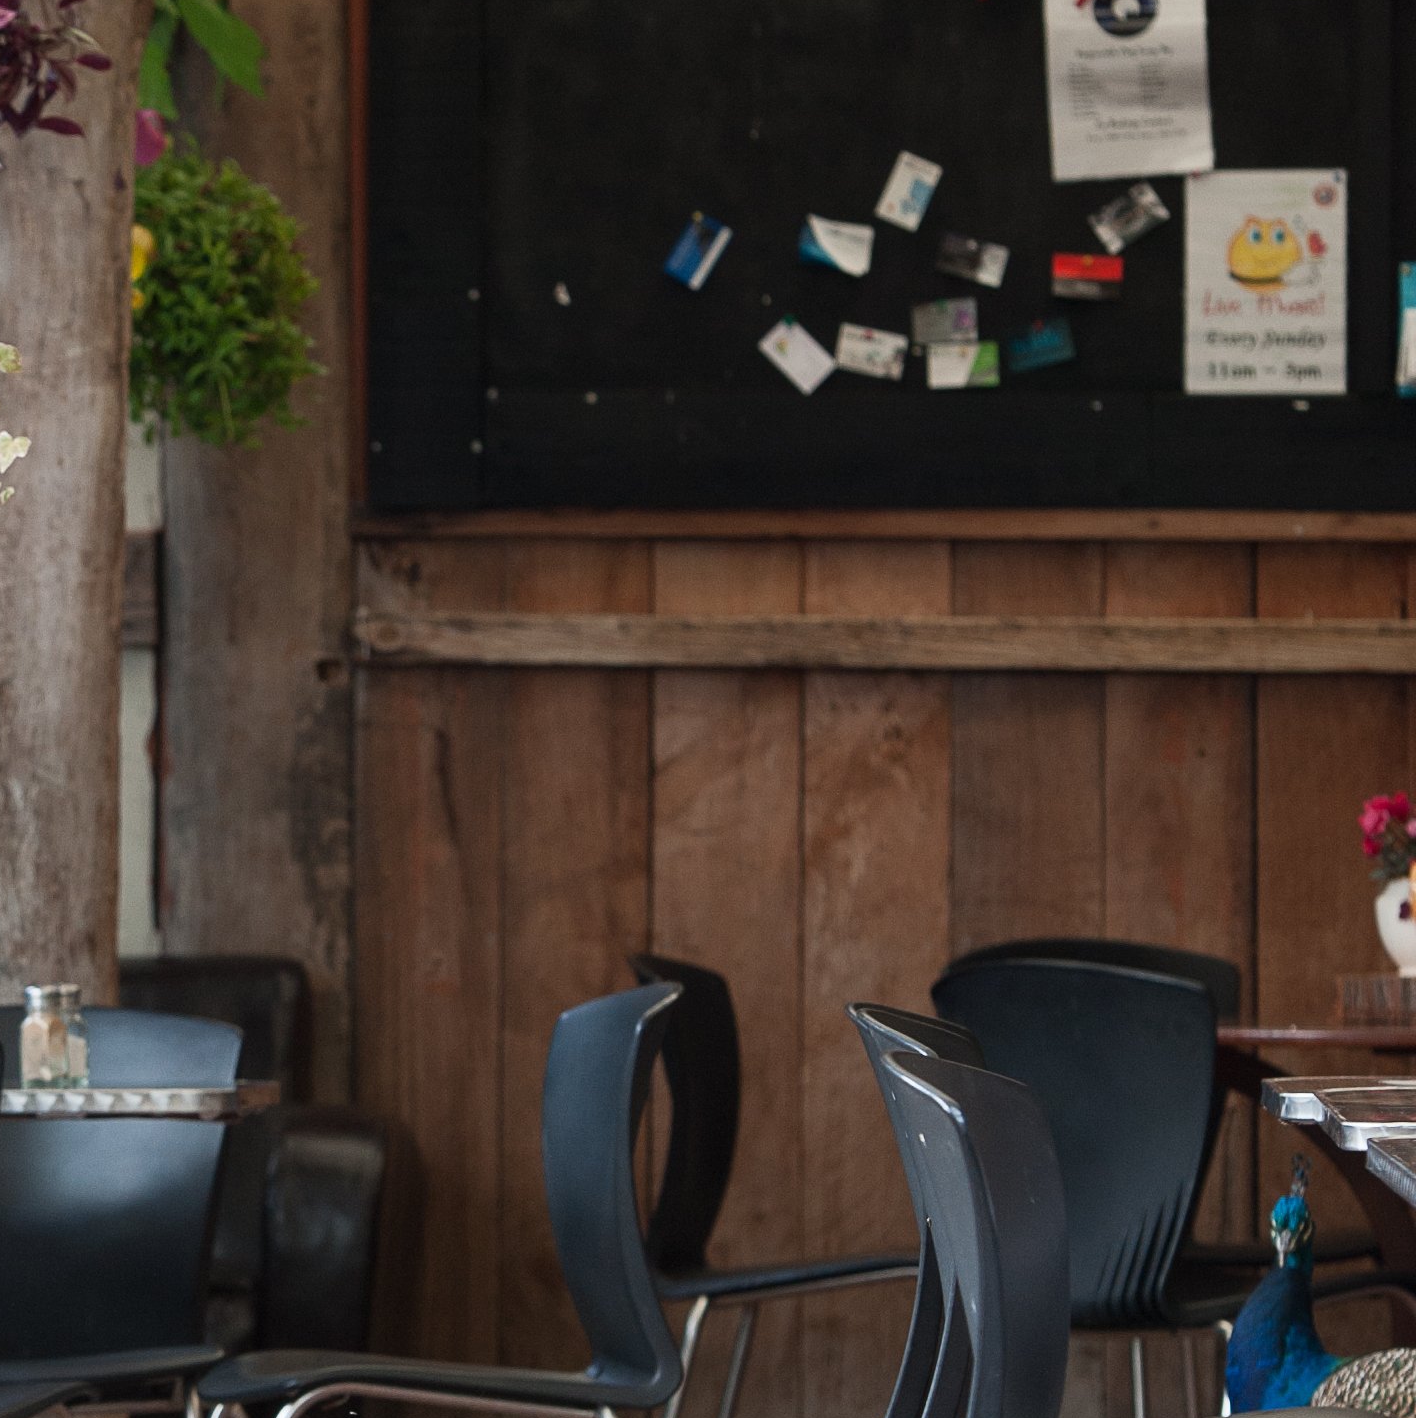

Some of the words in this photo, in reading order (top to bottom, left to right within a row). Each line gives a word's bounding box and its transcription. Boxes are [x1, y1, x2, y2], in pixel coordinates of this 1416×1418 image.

[1206, 331, 1257, 352] Every
[1261, 328, 1327, 351] Sunday
[1208, 361, 1257, 379] 11am
